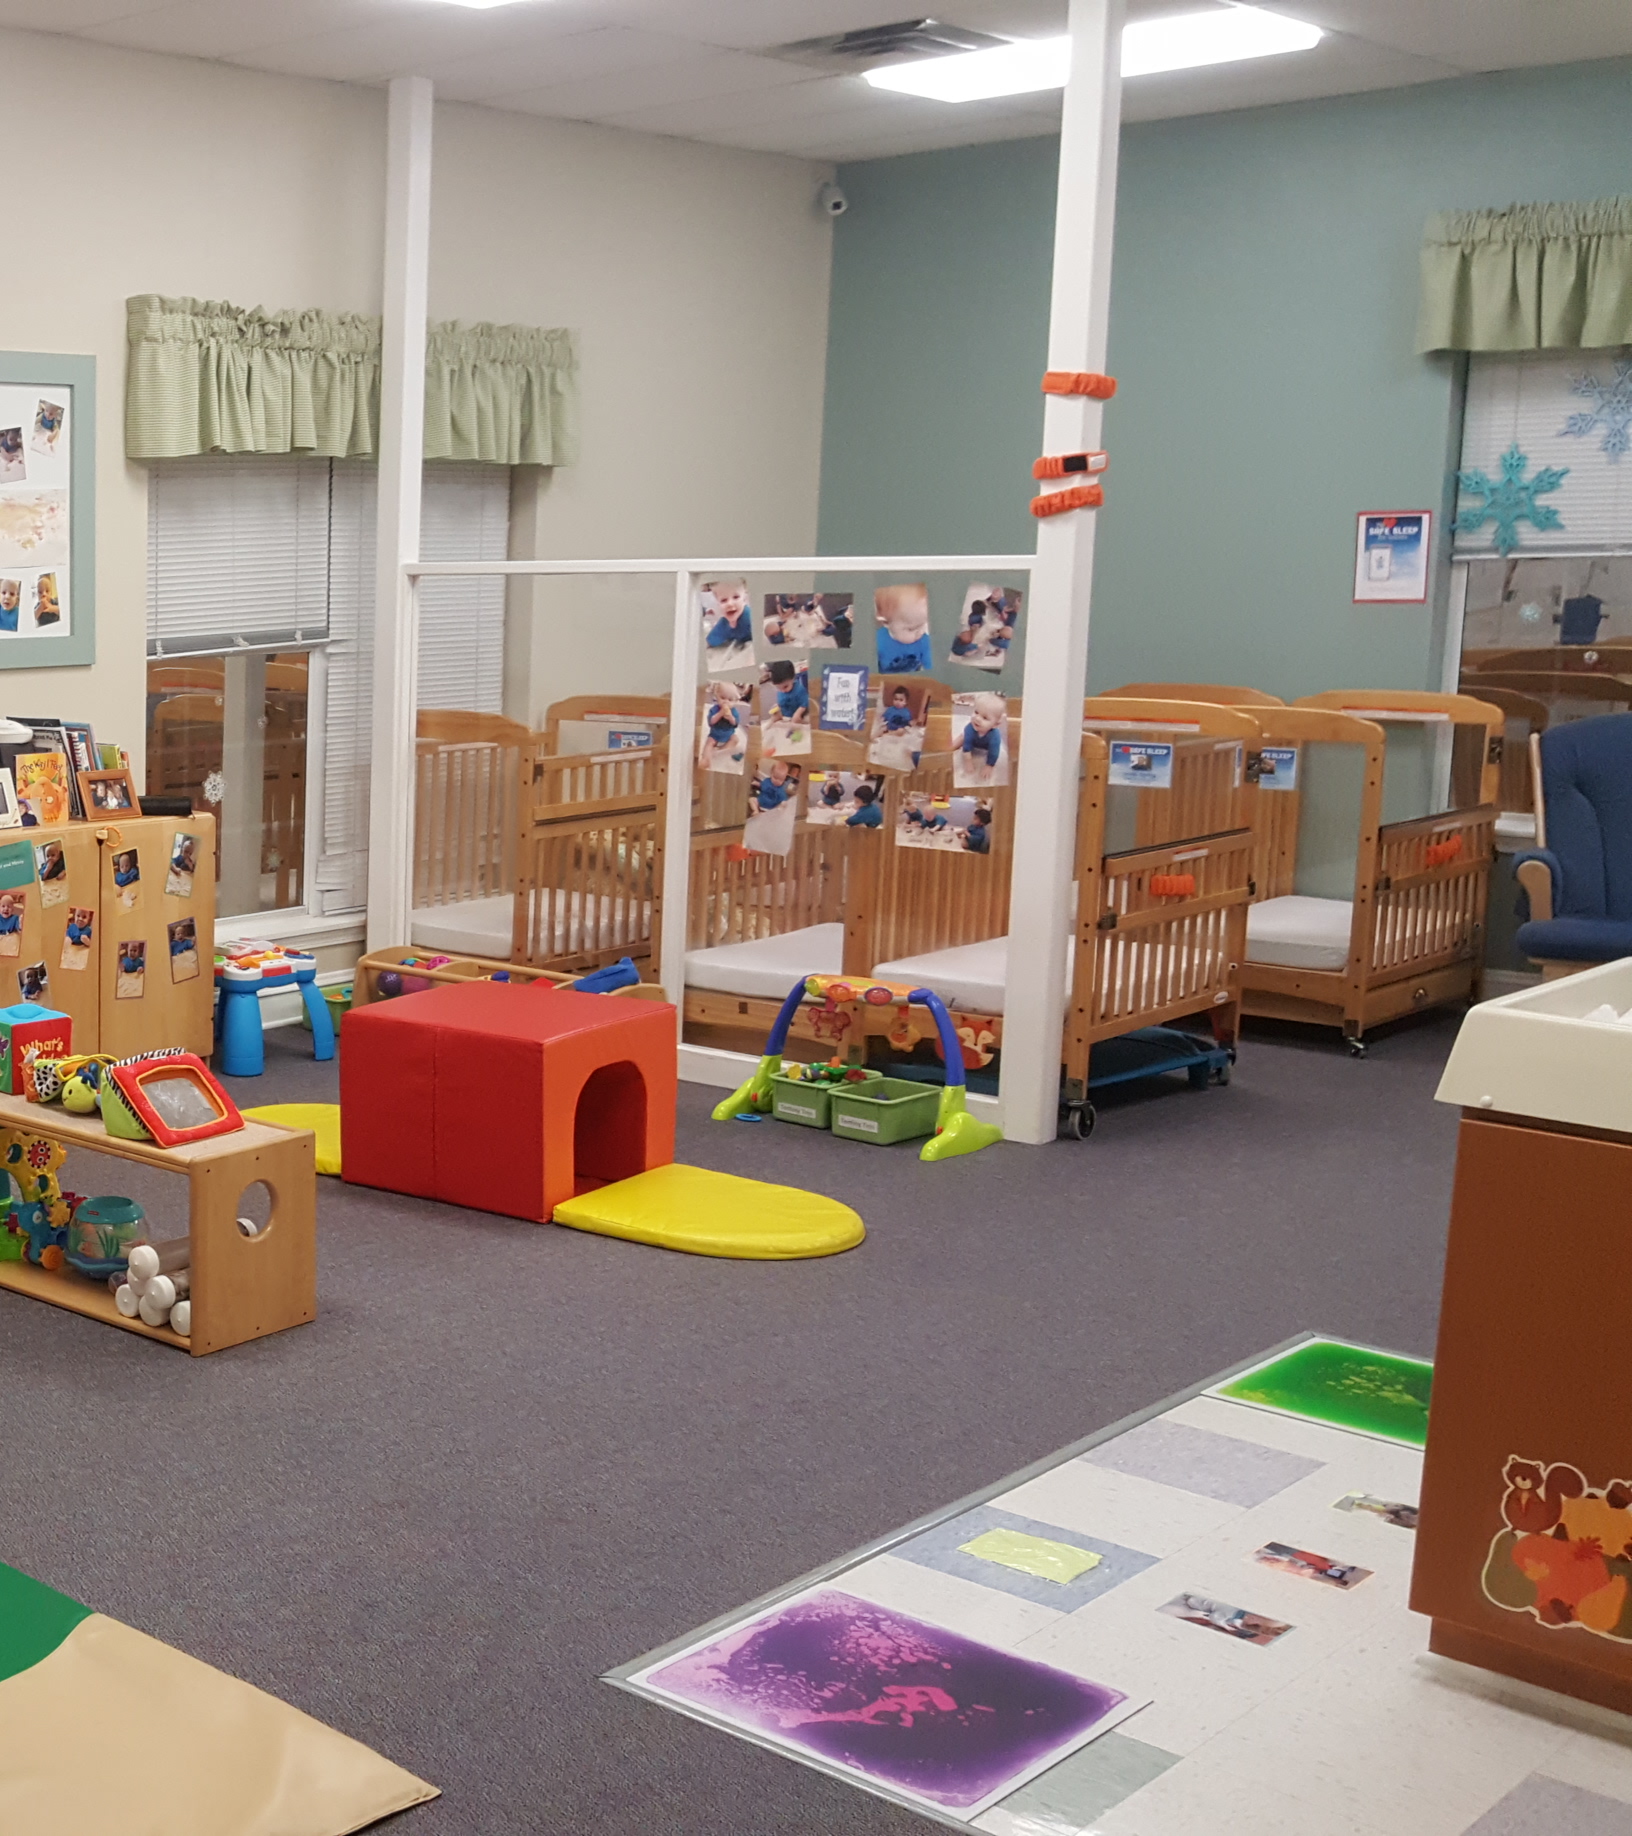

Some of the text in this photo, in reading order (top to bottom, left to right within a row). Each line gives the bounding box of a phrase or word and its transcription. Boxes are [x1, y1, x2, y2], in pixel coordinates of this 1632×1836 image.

[1369, 526, 1419, 536] SAFE SLEEP
[20, 1037, 64, 1056] What's
